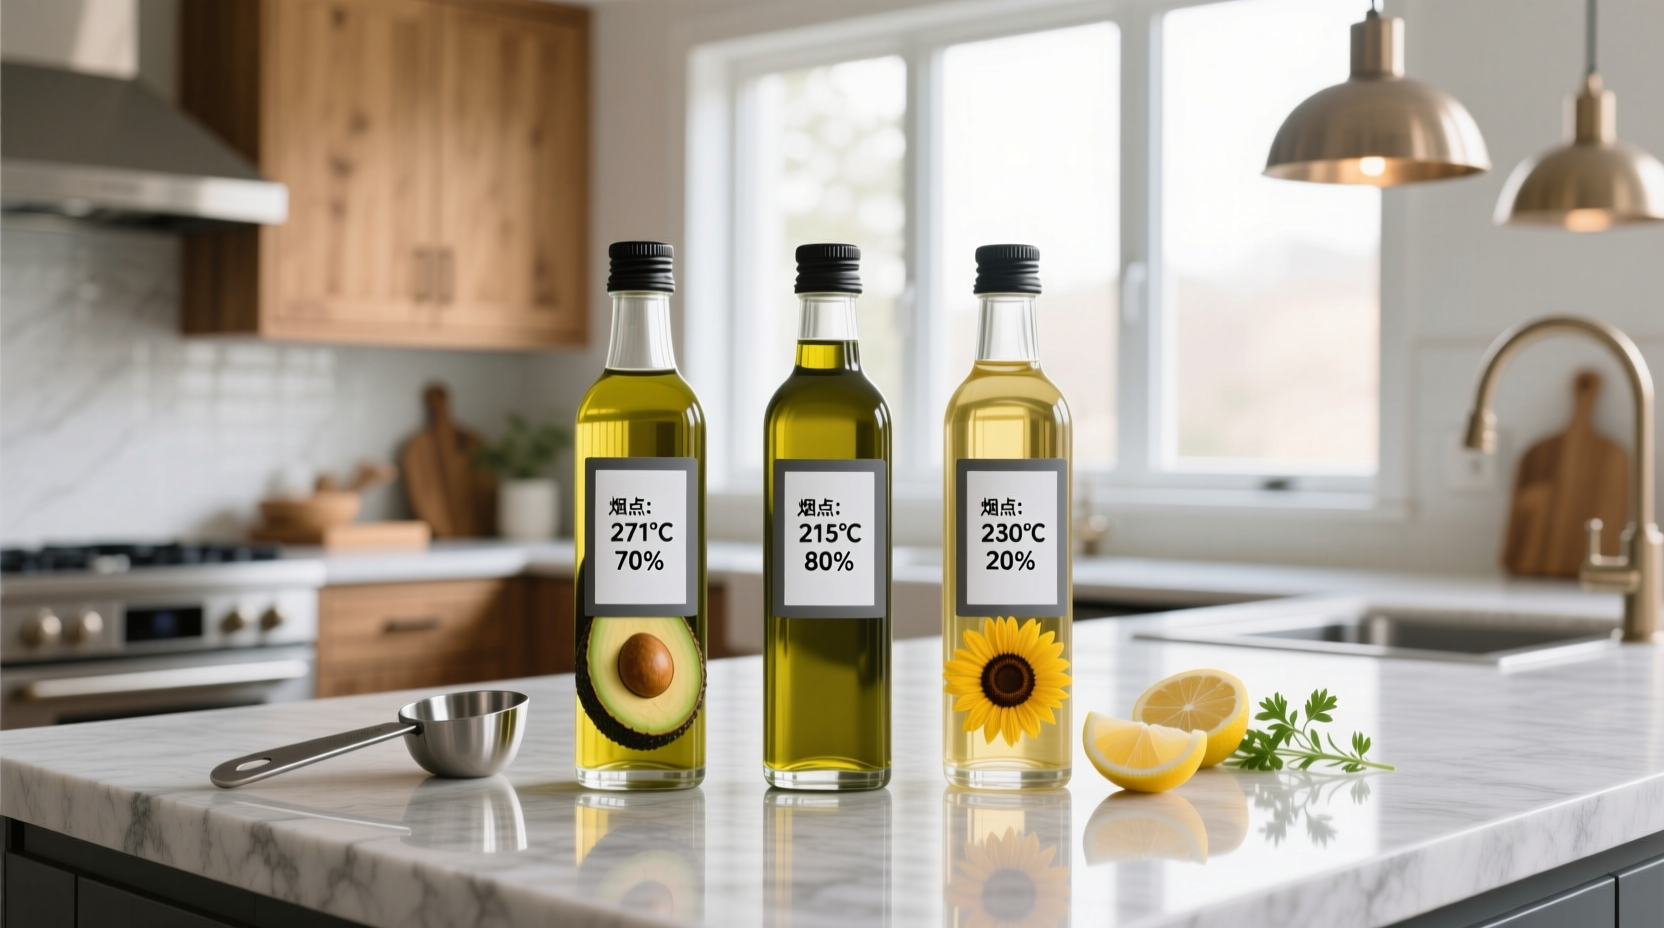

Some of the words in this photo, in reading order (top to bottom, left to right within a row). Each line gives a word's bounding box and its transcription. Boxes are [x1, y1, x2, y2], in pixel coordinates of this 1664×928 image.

[610, 522, 674, 543] 271°C
[799, 522, 862, 543] 215°C
[981, 522, 1046, 543] 230°C
[614, 550, 664, 571] 70%
[804, 550, 854, 571] 80%
[985, 550, 1036, 571] 20%
